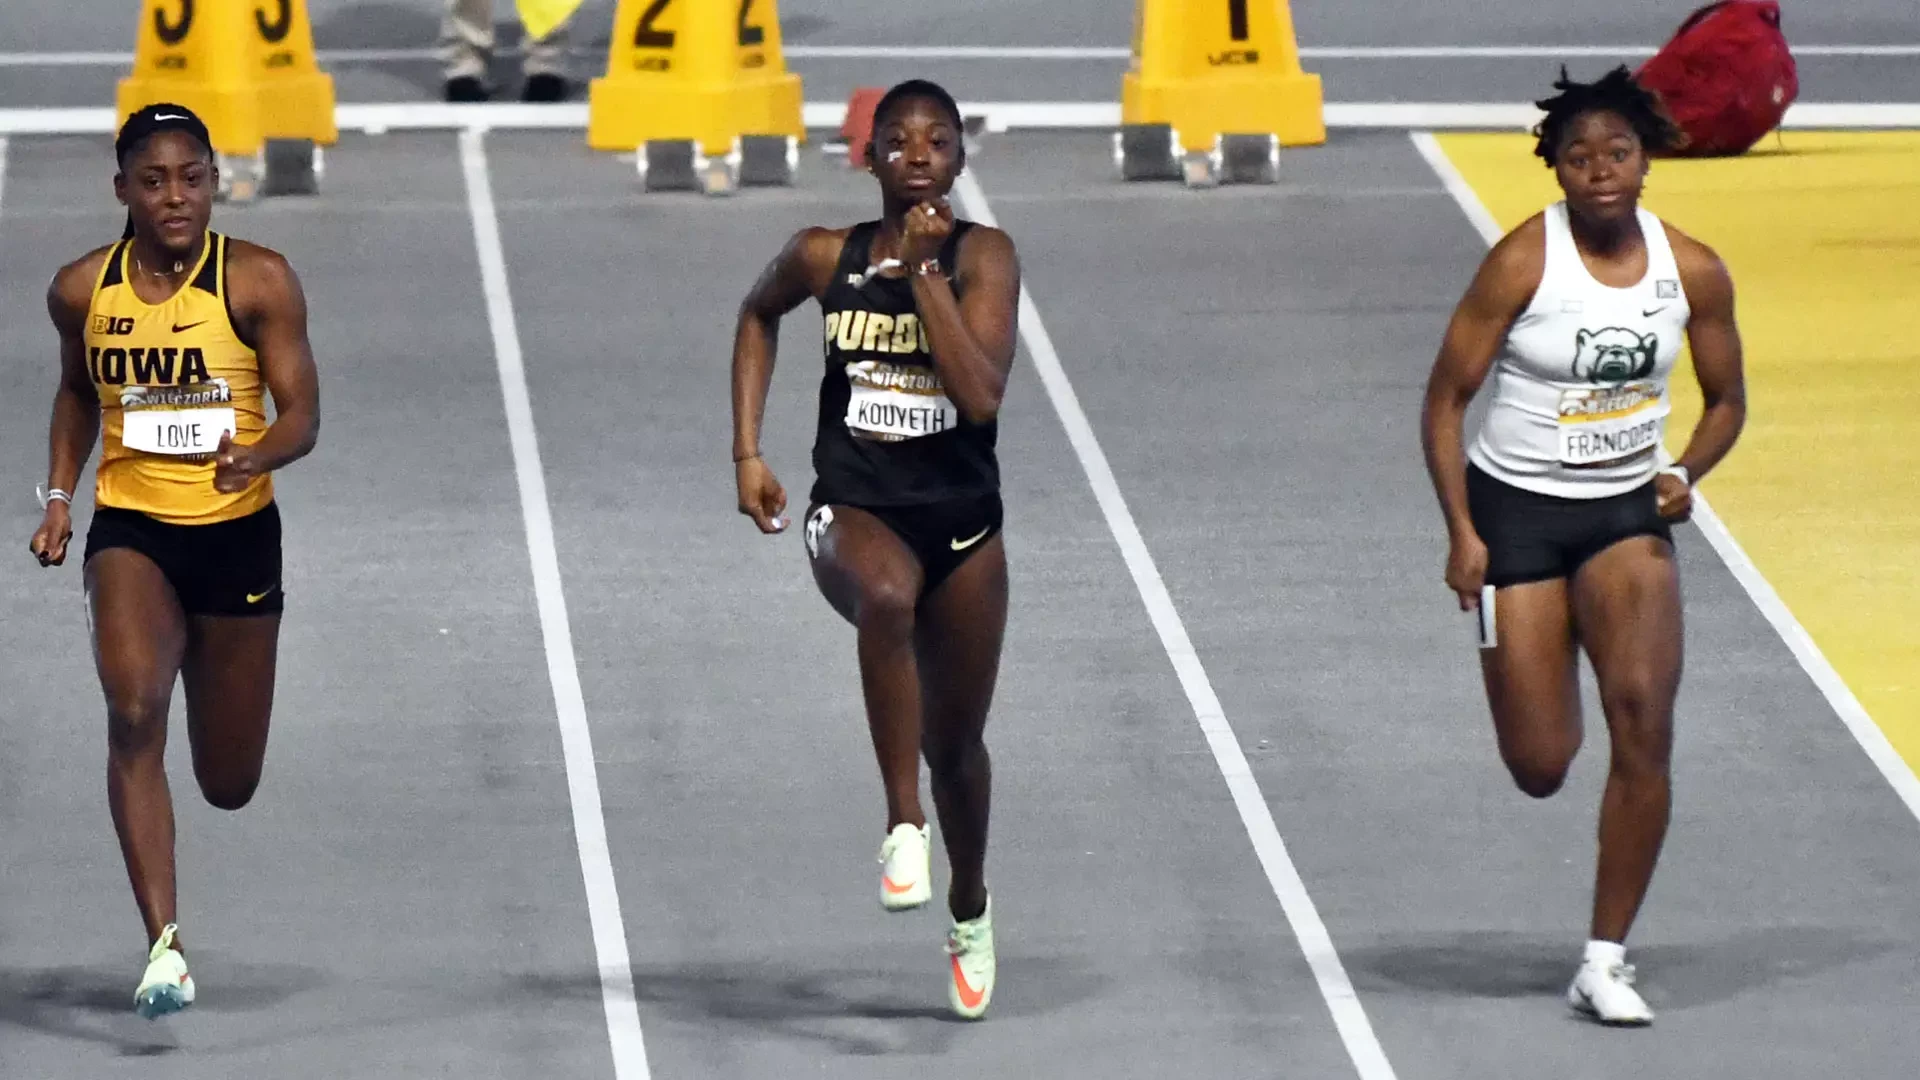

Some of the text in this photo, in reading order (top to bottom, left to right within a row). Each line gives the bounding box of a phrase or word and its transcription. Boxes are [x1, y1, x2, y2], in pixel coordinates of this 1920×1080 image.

[635, 0, 675, 47] 2
[90, 347, 211, 385] IOWA
[858, 400, 945, 432] KOUYETH
[157, 423, 203, 448] LOVE
